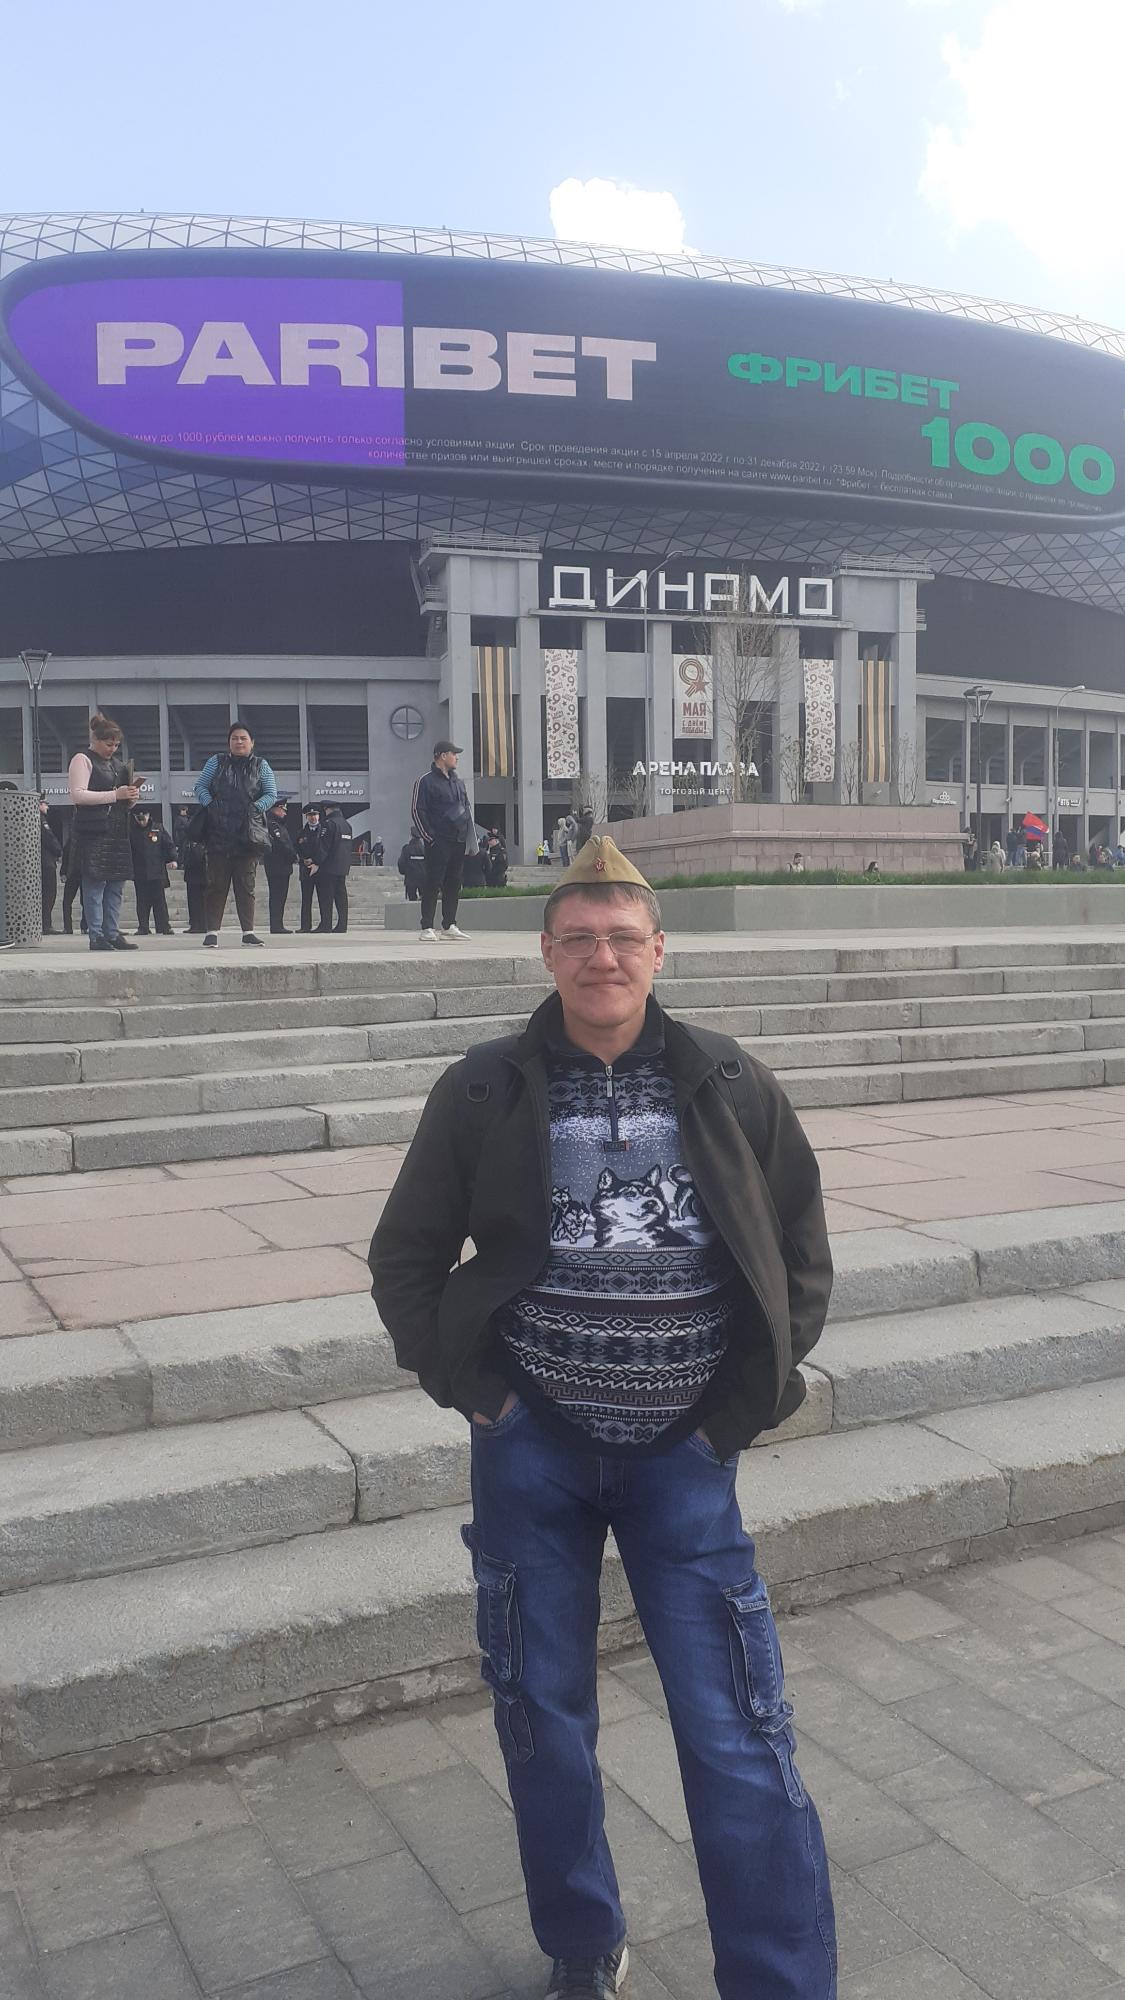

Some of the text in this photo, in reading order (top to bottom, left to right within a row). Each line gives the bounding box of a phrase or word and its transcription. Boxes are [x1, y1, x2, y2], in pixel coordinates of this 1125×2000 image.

[96, 321, 657, 401] PARIBET
[727, 352, 960, 410] ФРИБЕТ
[178, 432, 203, 442] 1000
[206, 432, 244, 443] рублей
[247, 434, 282, 443] можно
[285, 435, 333, 444] получить
[337, 435, 372, 444] только
[375, 437, 422, 446] согласно
[521, 441, 545, 451] Срок
[549, 442, 608, 453] проведения
[611, 446, 639, 457] акции
[651, 448, 662, 458] 15
[665, 450, 699, 461] апреля
[701, 452, 723, 463] 2022
[733, 456, 745, 465] по
[747, 455, 758, 465] 31
[760, 458, 797, 469] декабря
[800, 460, 820, 471] 2022
[368, 450, 428, 461] количестве
[431, 452, 467, 463] призов
[470, 453, 489, 462] или
[492, 455, 551, 466] выигрышей
[593, 460, 622, 470] месте
[634, 462, 672, 473] порядке
[676, 464, 726, 476] получения
[921, 416, 1115, 495] 1000
[549, 565, 833, 616] ДИНАМО
[682, 702, 707, 717] МАЯ
[632, 760, 697, 776] АРЕНА
[315, 787, 347, 796] детский
[661, 787, 705, 796] ТОРГОВЫЙ
